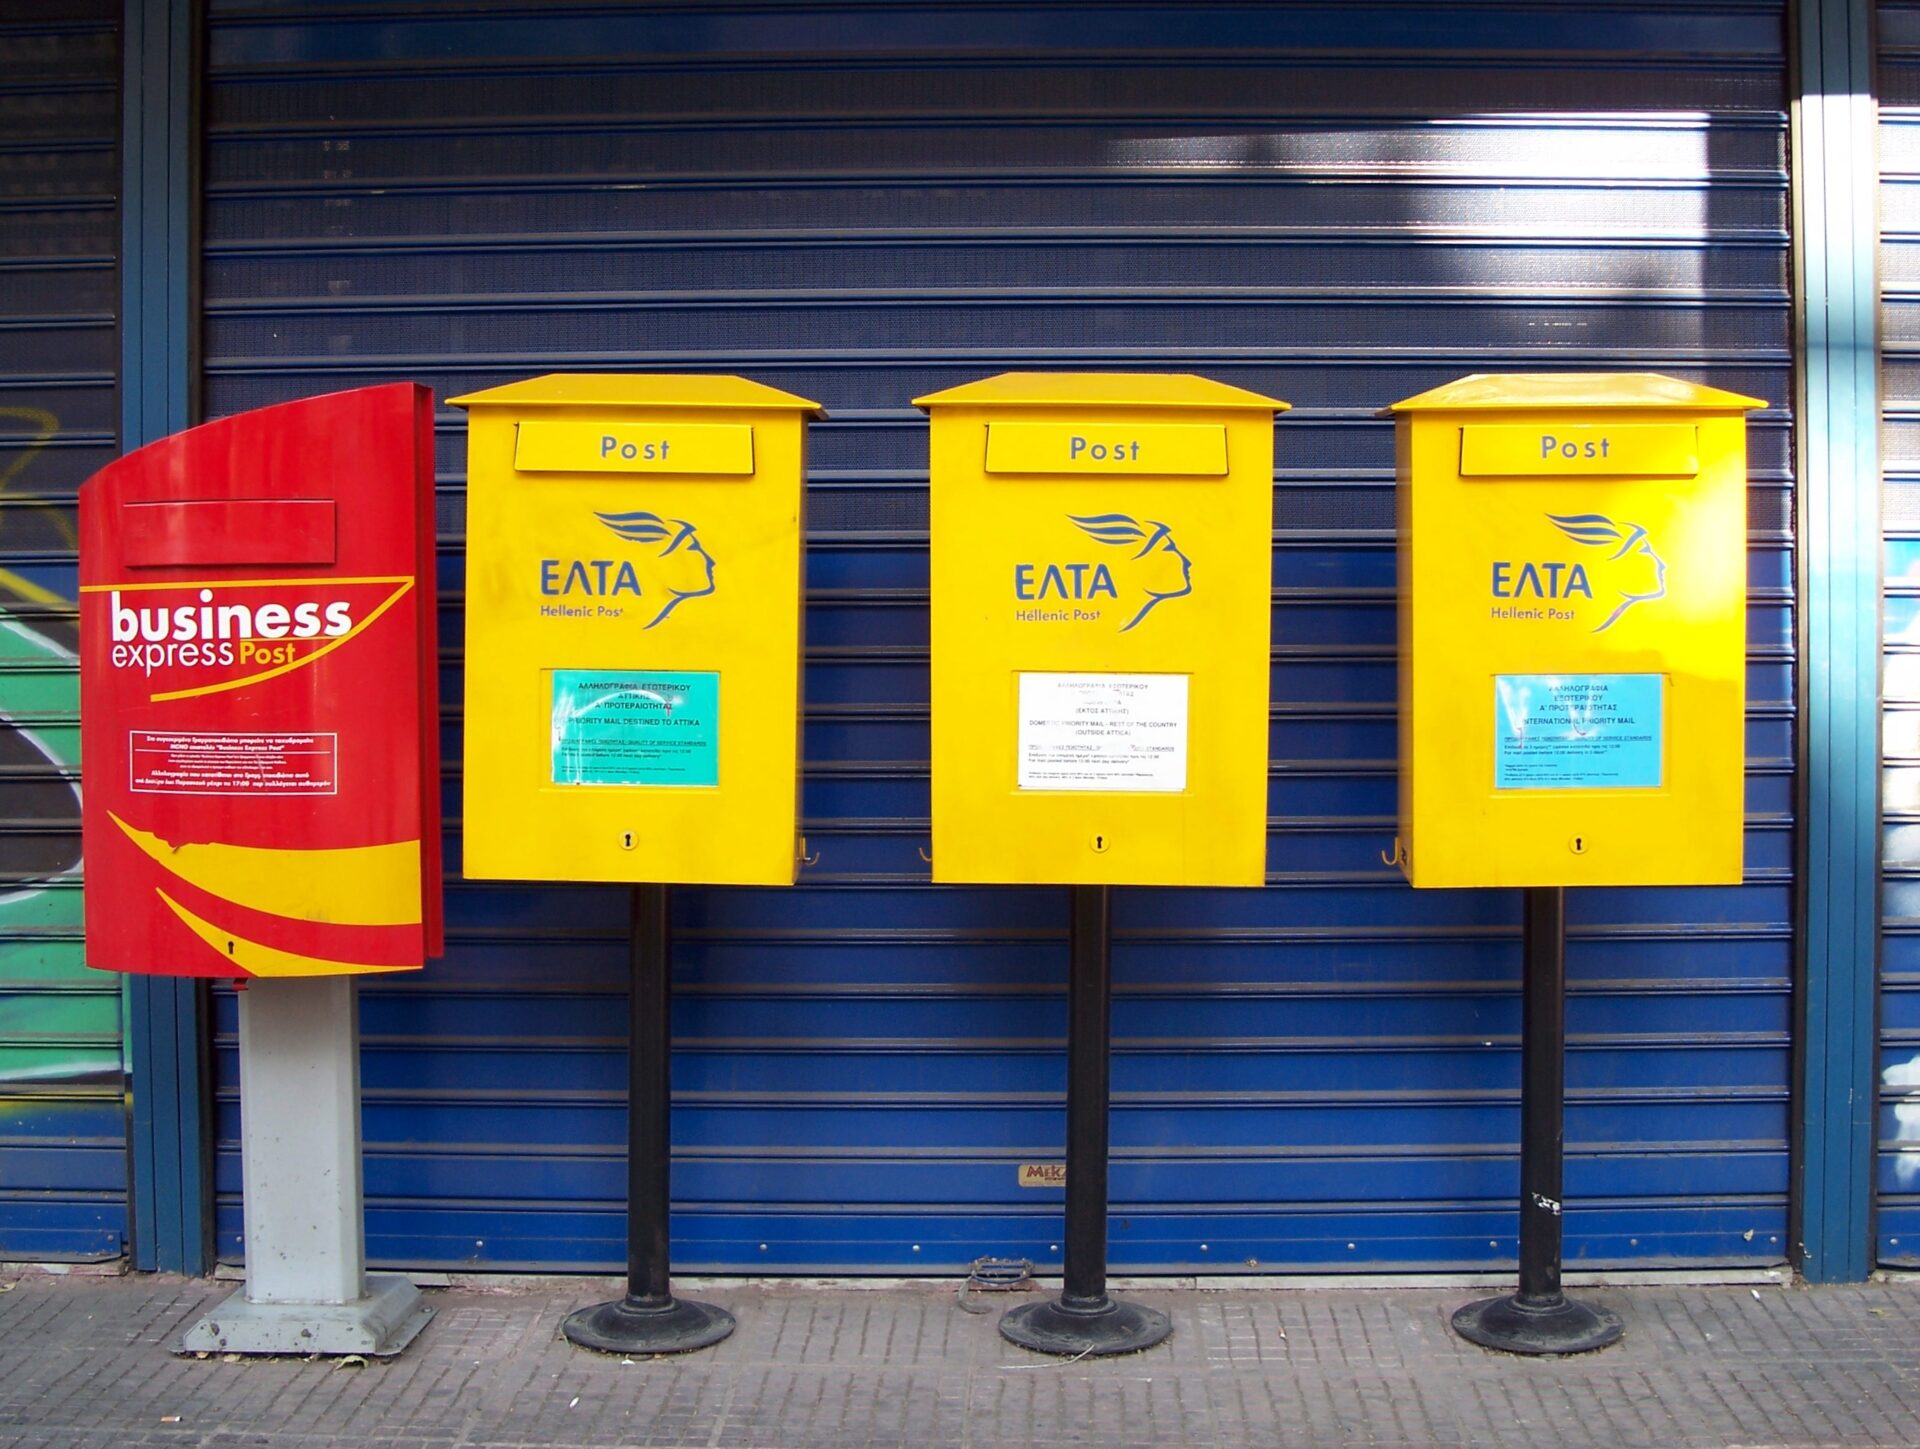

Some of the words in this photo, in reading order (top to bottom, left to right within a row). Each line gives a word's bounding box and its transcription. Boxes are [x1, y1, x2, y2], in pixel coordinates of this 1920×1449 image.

[601, 436, 669, 460] Post
[1071, 437, 1139, 461] Post
[1541, 436, 1609, 458] Post
[541, 560, 642, 597] ΕΛΤΑ
[1015, 563, 1118, 600] ΕΛΤΑ
[1492, 562, 1593, 599] ΕΛΤΑ
[111, 588, 352, 642] business
[540, 604, 593, 617] Hellenic
[597, 605, 624, 617] Post
[1016, 609, 1070, 621] Hellenic
[1073, 608, 1101, 621] Post
[1491, 607, 1544, 620] Hellenic
[1548, 608, 1575, 620] Post
[112, 642, 235, 678] express
[240, 641, 296, 665] Post
[624, 718, 660, 726] DESTINED
[662, 718, 672, 726] TO
[674, 719, 700, 727] ATTIKA
